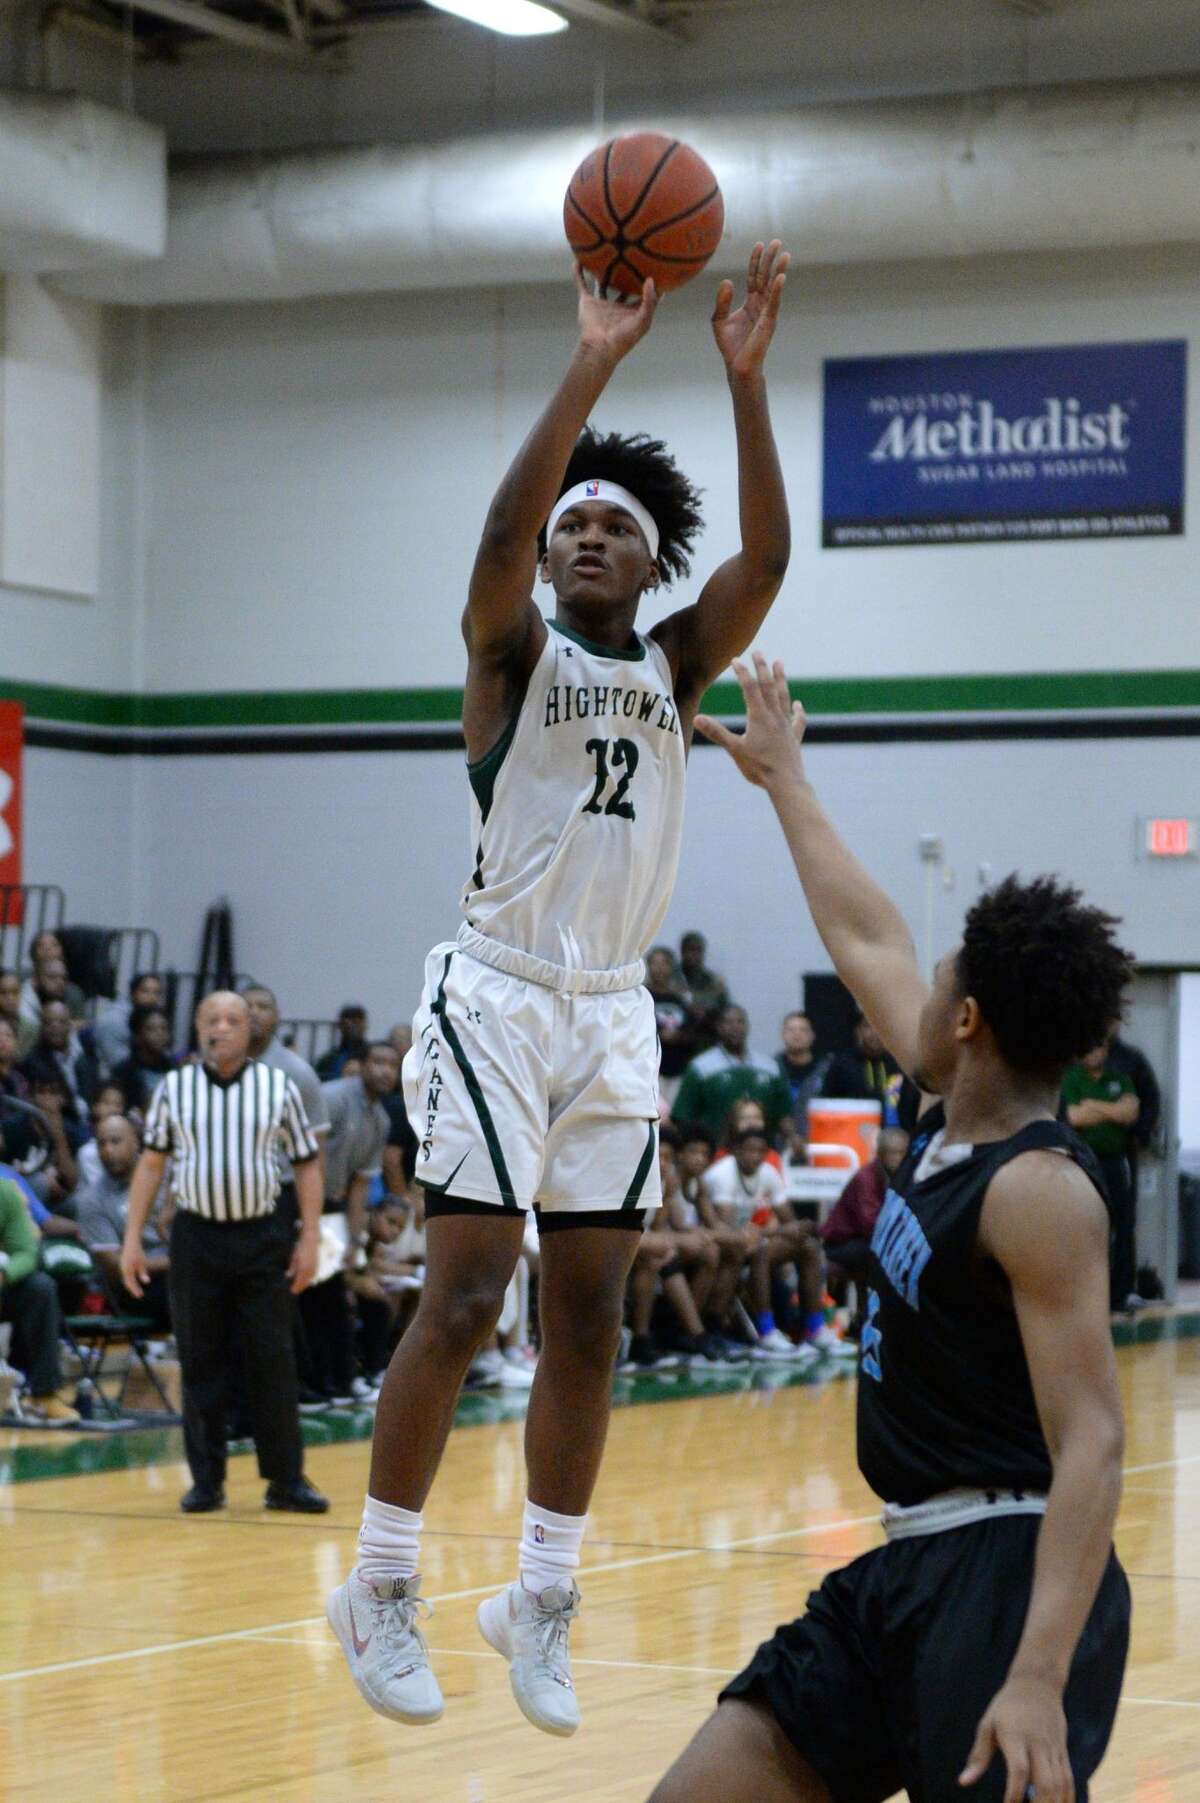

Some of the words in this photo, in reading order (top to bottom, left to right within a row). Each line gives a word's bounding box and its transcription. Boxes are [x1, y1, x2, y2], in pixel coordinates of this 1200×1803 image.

[869, 393, 974, 414] HOUSTON
[869, 398, 1130, 461] Methodist
[918, 464, 979, 482] SUGAR
[985, 461, 1036, 480] LAND
[1041, 458, 1128, 479] HOSPITAL
[582, 737, 640, 822] 12
